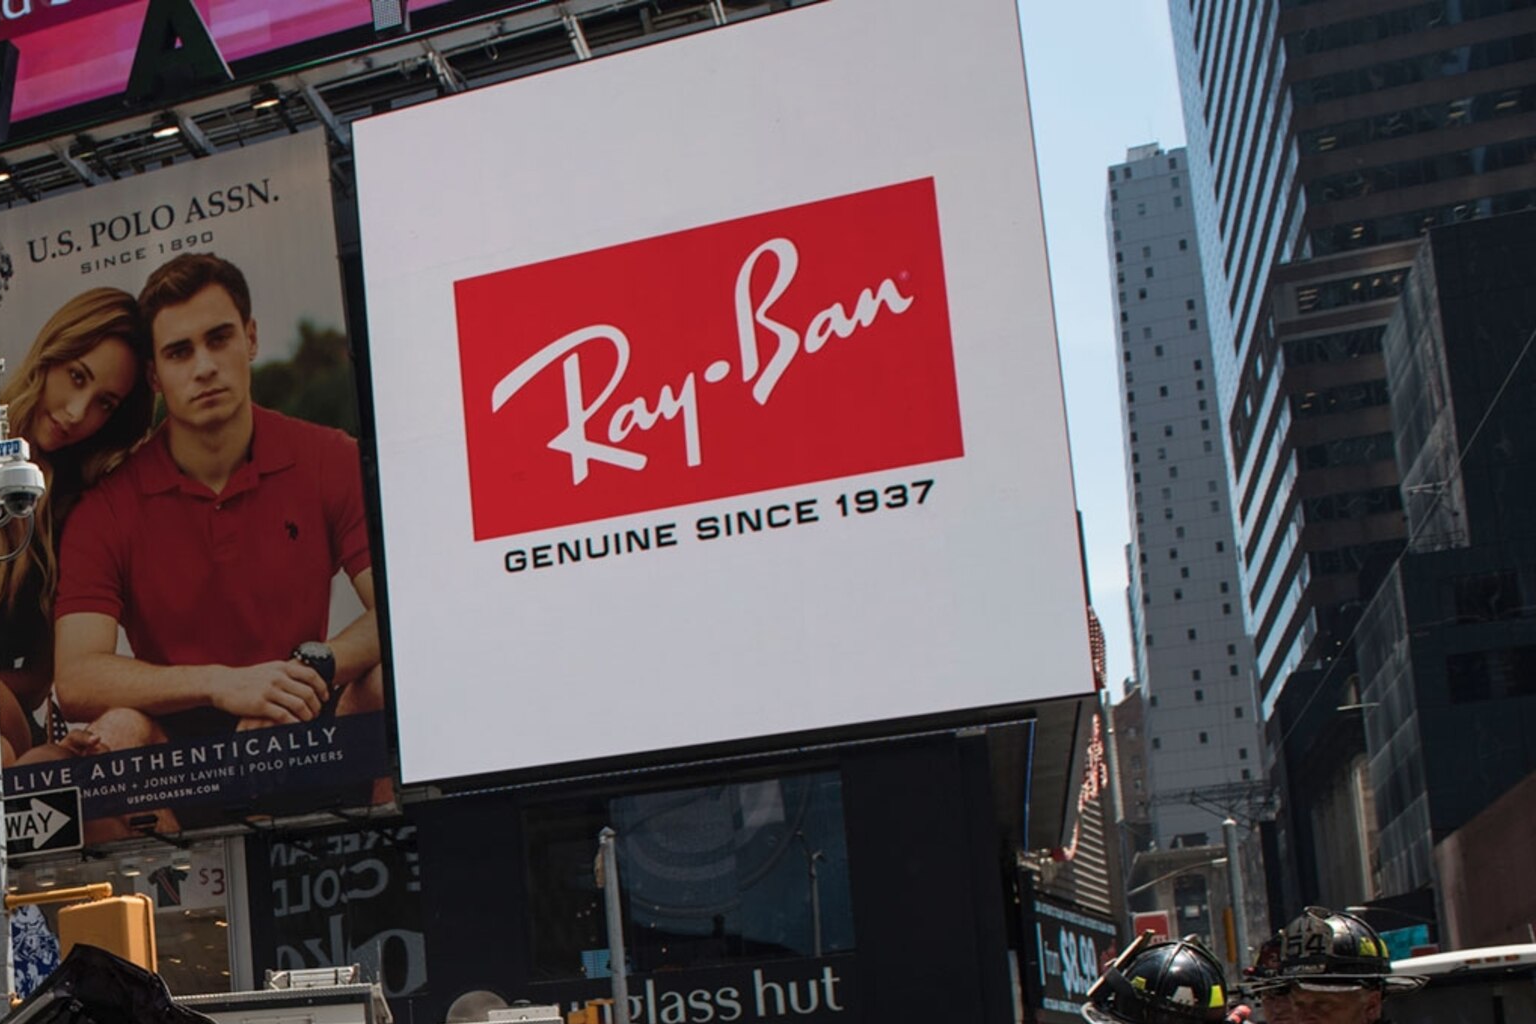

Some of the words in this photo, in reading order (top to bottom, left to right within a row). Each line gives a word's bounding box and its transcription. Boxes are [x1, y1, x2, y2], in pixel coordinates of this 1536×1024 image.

[28, 231, 81, 263] U.S.
[90, 204, 175, 248] POLO
[185, 179, 280, 225] ASSN.
[81, 248, 146, 274] SINCE
[160, 231, 214, 254] 1890
[503, 524, 678, 573] GENUINE
[695, 500, 820, 541] SINCE
[836, 479, 935, 518] 1937
[15, 767, 73, 791] LIVE
[91, 726, 337, 781] AUTHENTICALLY
[143, 774, 187, 790] JONNY
[190, 766, 236, 782] LAVINE
[249, 759, 284, 774] POLO
[289, 750, 344, 768] PLAYERS
[5, 811, 53, 838] WAY
[753, 966, 844, 1017] hut
